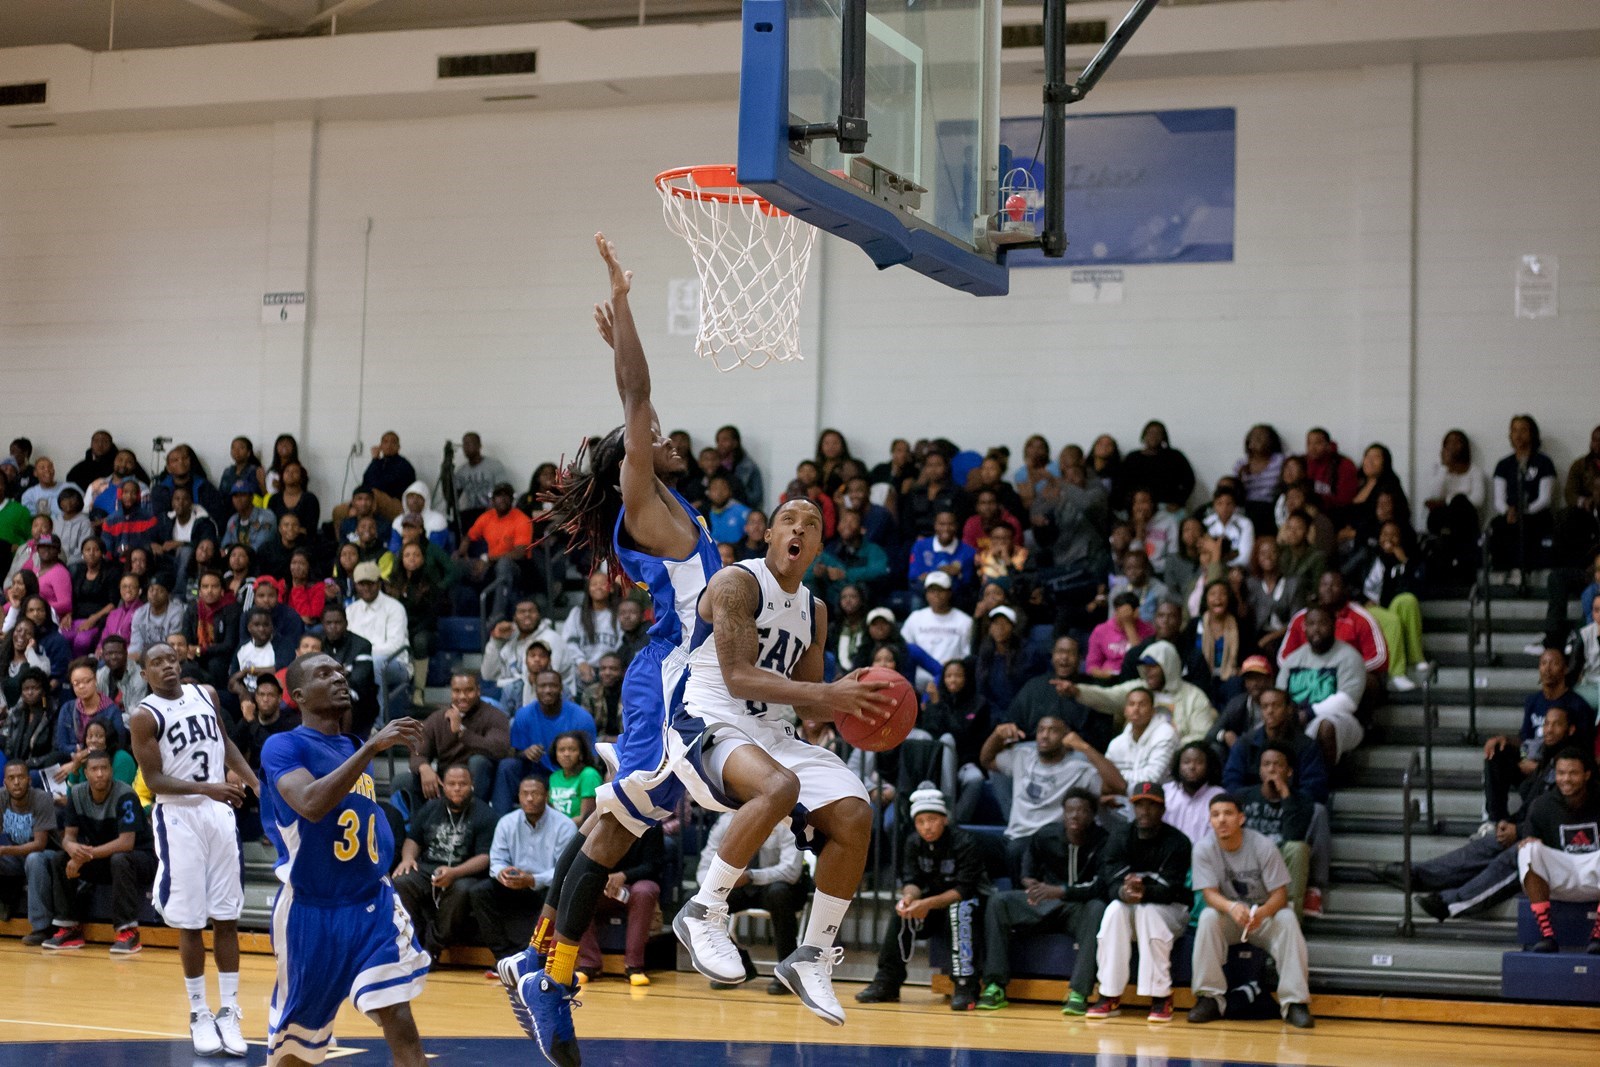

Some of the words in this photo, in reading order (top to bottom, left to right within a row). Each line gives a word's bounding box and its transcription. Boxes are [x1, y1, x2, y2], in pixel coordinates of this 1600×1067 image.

[280, 305, 288, 321] 6
[166, 713, 218, 756] SAU
[191, 750, 209, 782] 3
[333, 808, 379, 865] 30
